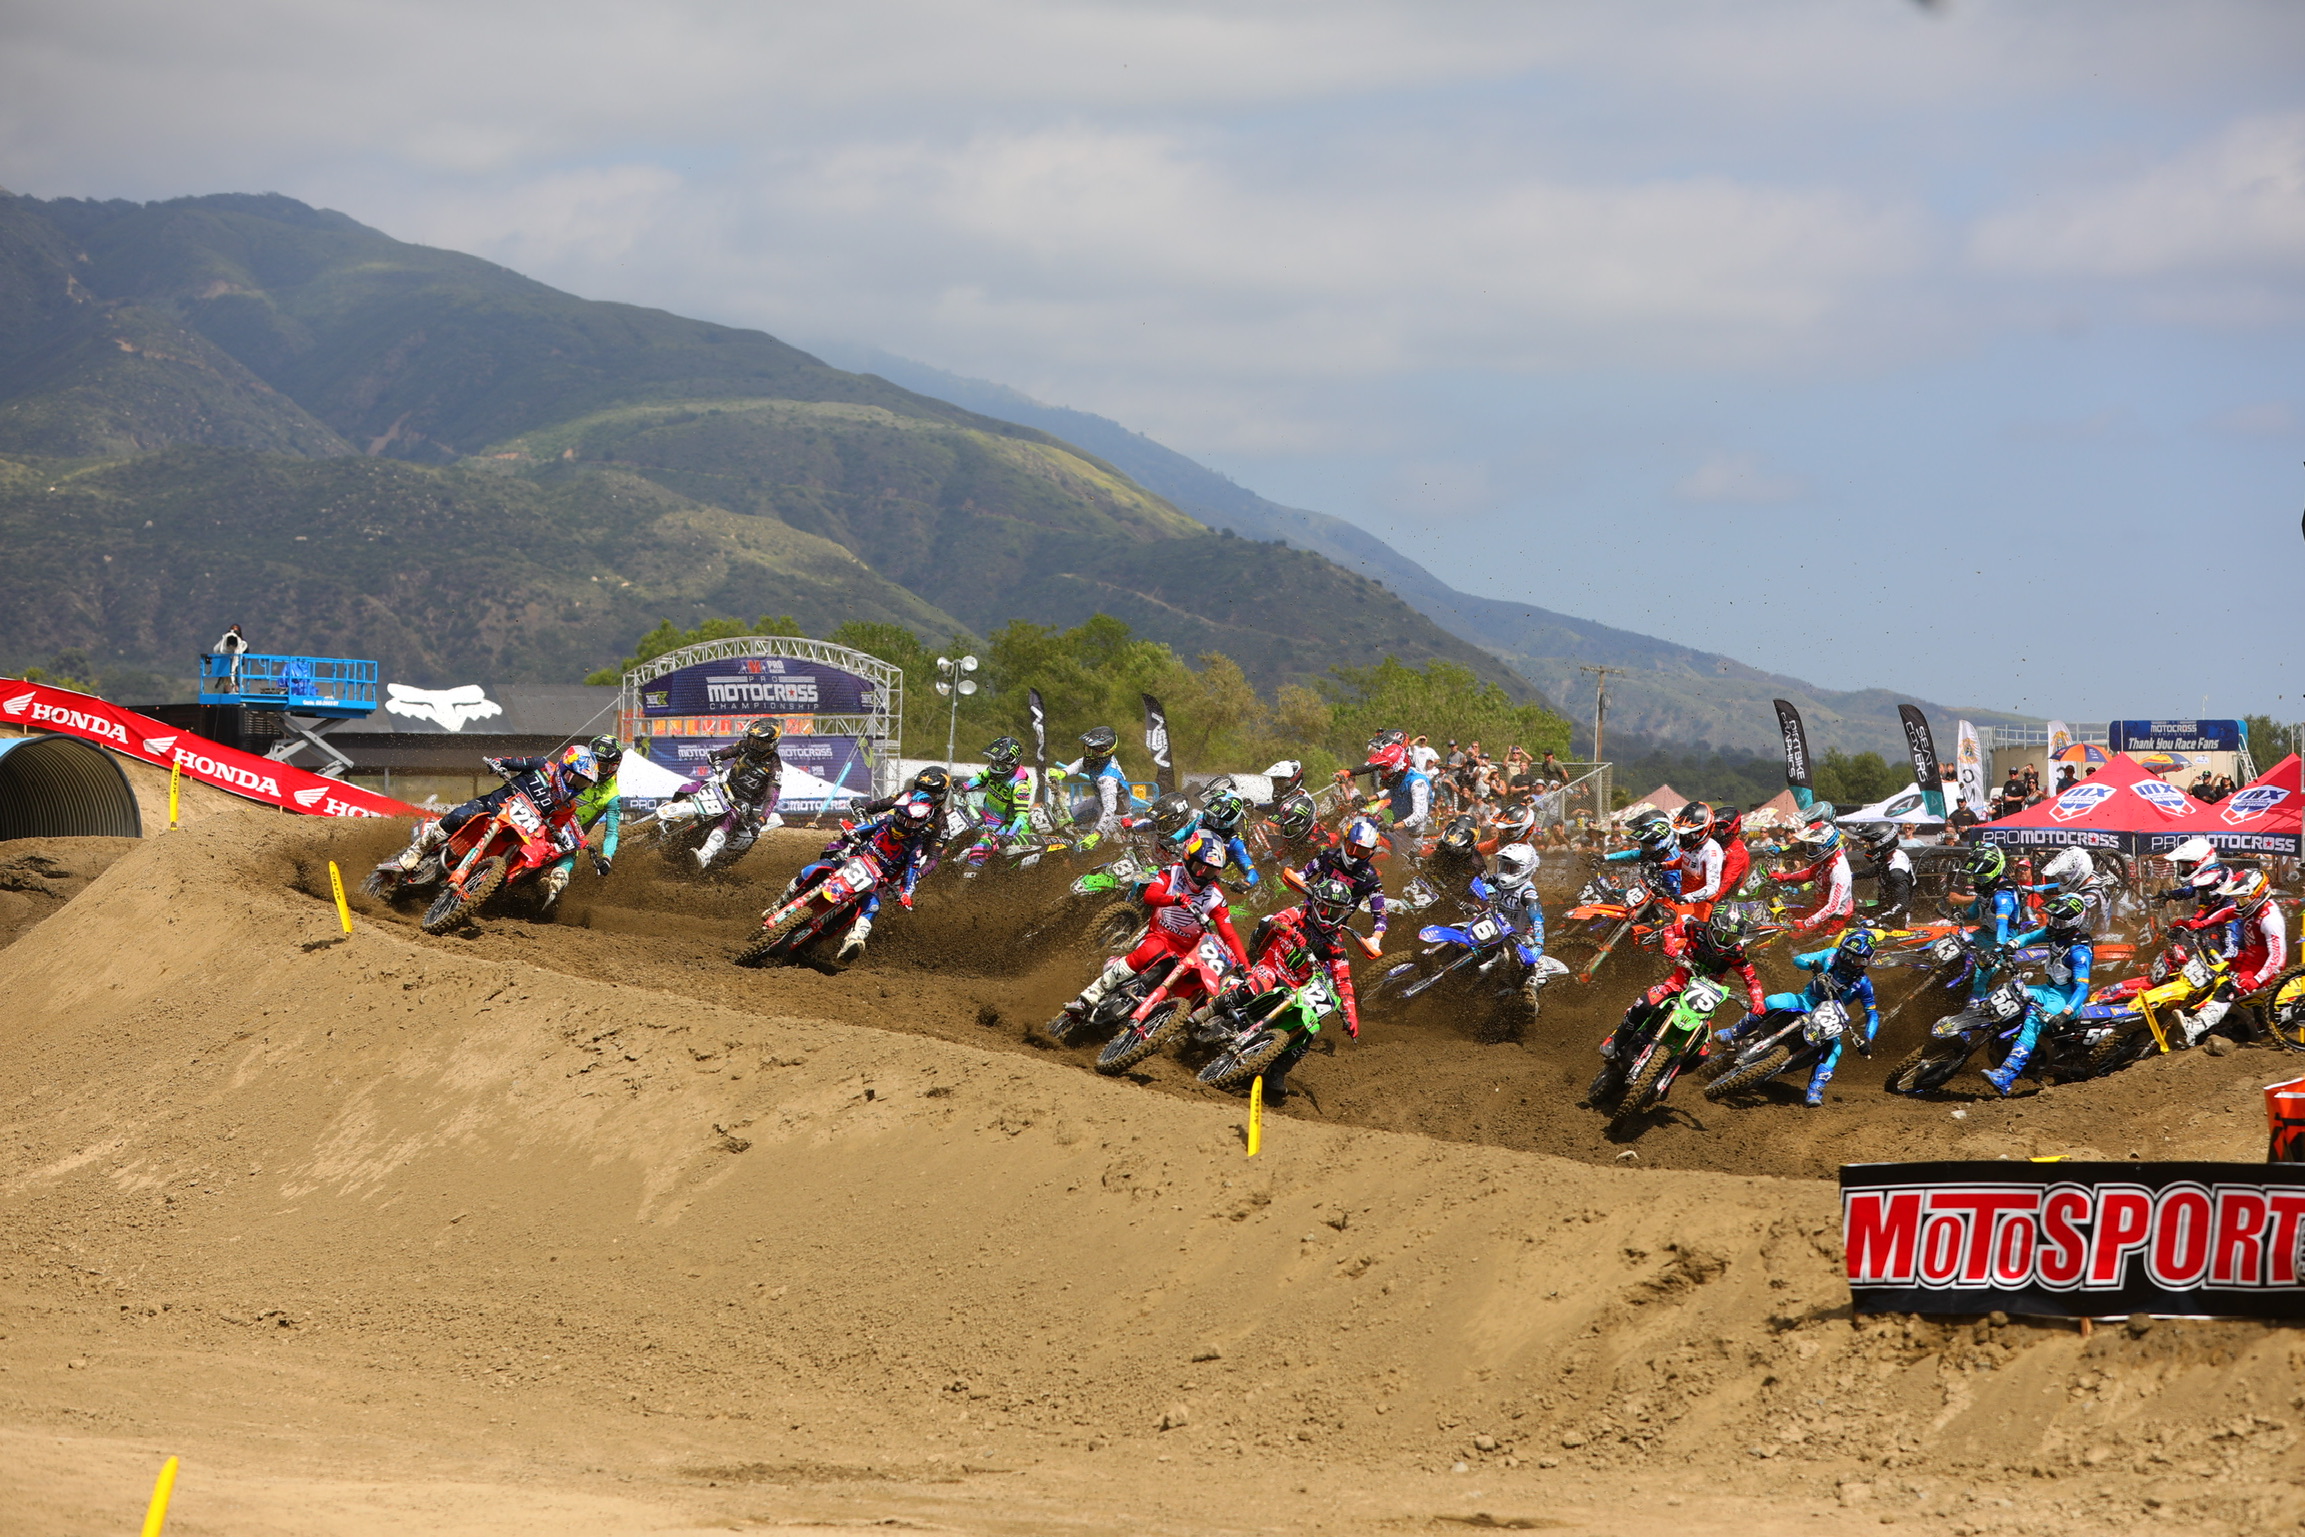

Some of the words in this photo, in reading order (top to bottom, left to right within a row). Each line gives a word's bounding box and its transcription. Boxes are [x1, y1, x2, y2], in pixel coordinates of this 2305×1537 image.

[707, 683, 818, 702] MOTOCROSS
[709, 703, 819, 711] CHAMPIONSHIP
[31, 702, 129, 745] HONDA
[2150, 724, 2197, 733] MOTOCROSS
[1780, 711, 1796, 778] GRAPHICS
[1788, 719, 1806, 780] DIRTBIKE
[1905, 721, 1929, 783] COVERS
[1916, 725, 1934, 768] SEAT
[2128, 738, 2155, 750] Thank
[2155, 739, 2174, 750] You
[2174, 738, 2195, 750] Race
[2197, 737, 2220, 750] Fans
[173, 747, 282, 798] HONDA
[508, 797, 542, 834] 128
[867, 840, 893, 866] GASGAS
[1982, 830, 2120, 849] PROMOTOCROSS
[842, 857, 873, 893] 31
[1158, 920, 1192, 939] HONDA
[1472, 919, 1497, 941] 6
[1199, 941, 1226, 978] 96
[2182, 958, 2208, 988] 85
[1301, 979, 1332, 1018] 124
[1684, 979, 1720, 1013] 75
[1985, 987, 2016, 1017] 58
